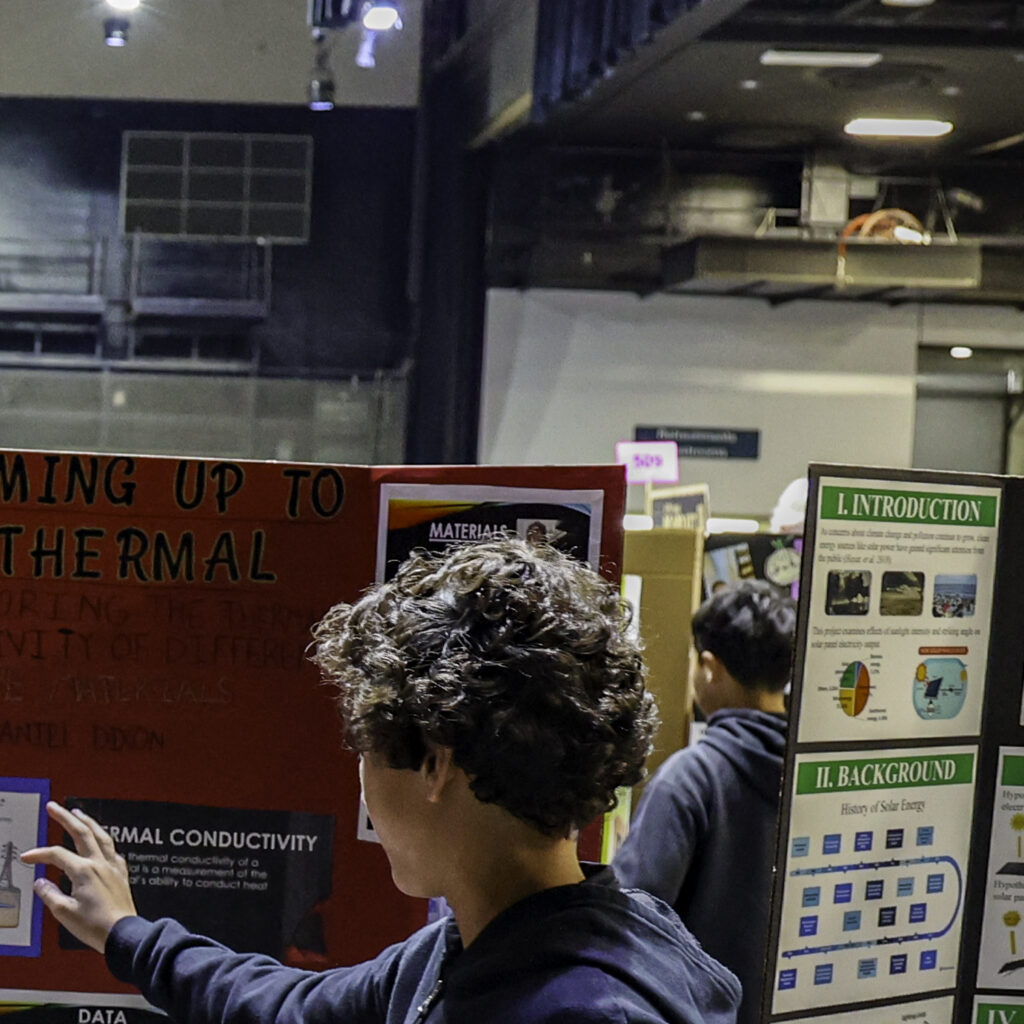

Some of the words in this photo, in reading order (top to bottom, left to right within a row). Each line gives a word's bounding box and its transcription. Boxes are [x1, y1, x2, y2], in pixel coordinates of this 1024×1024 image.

[175, 459, 245, 514] UP
[283, 467, 346, 519] TO
[837, 492, 848, 515] I.
[851, 493, 983, 522] INTRODUCTION
[815, 766, 833, 790] II.
[837, 759, 957, 788] BACKGROUND
[840, 802, 868, 817] History
[870, 801, 878, 814] of
[879, 800, 900, 813] Solar
[900, 798, 926, 813] Energy
[169, 828, 318, 851] CONDUCTIVITY
[128, 852, 168, 863] thermal
[171, 854, 234, 867] conductivity
[237, 857, 248, 866] of
[251, 859, 260, 867] a
[162, 866, 234, 877] measurement
[182, 878, 193, 887] to
[195, 878, 241, 889] conduct
[78, 1008, 127, 1024] DATA
